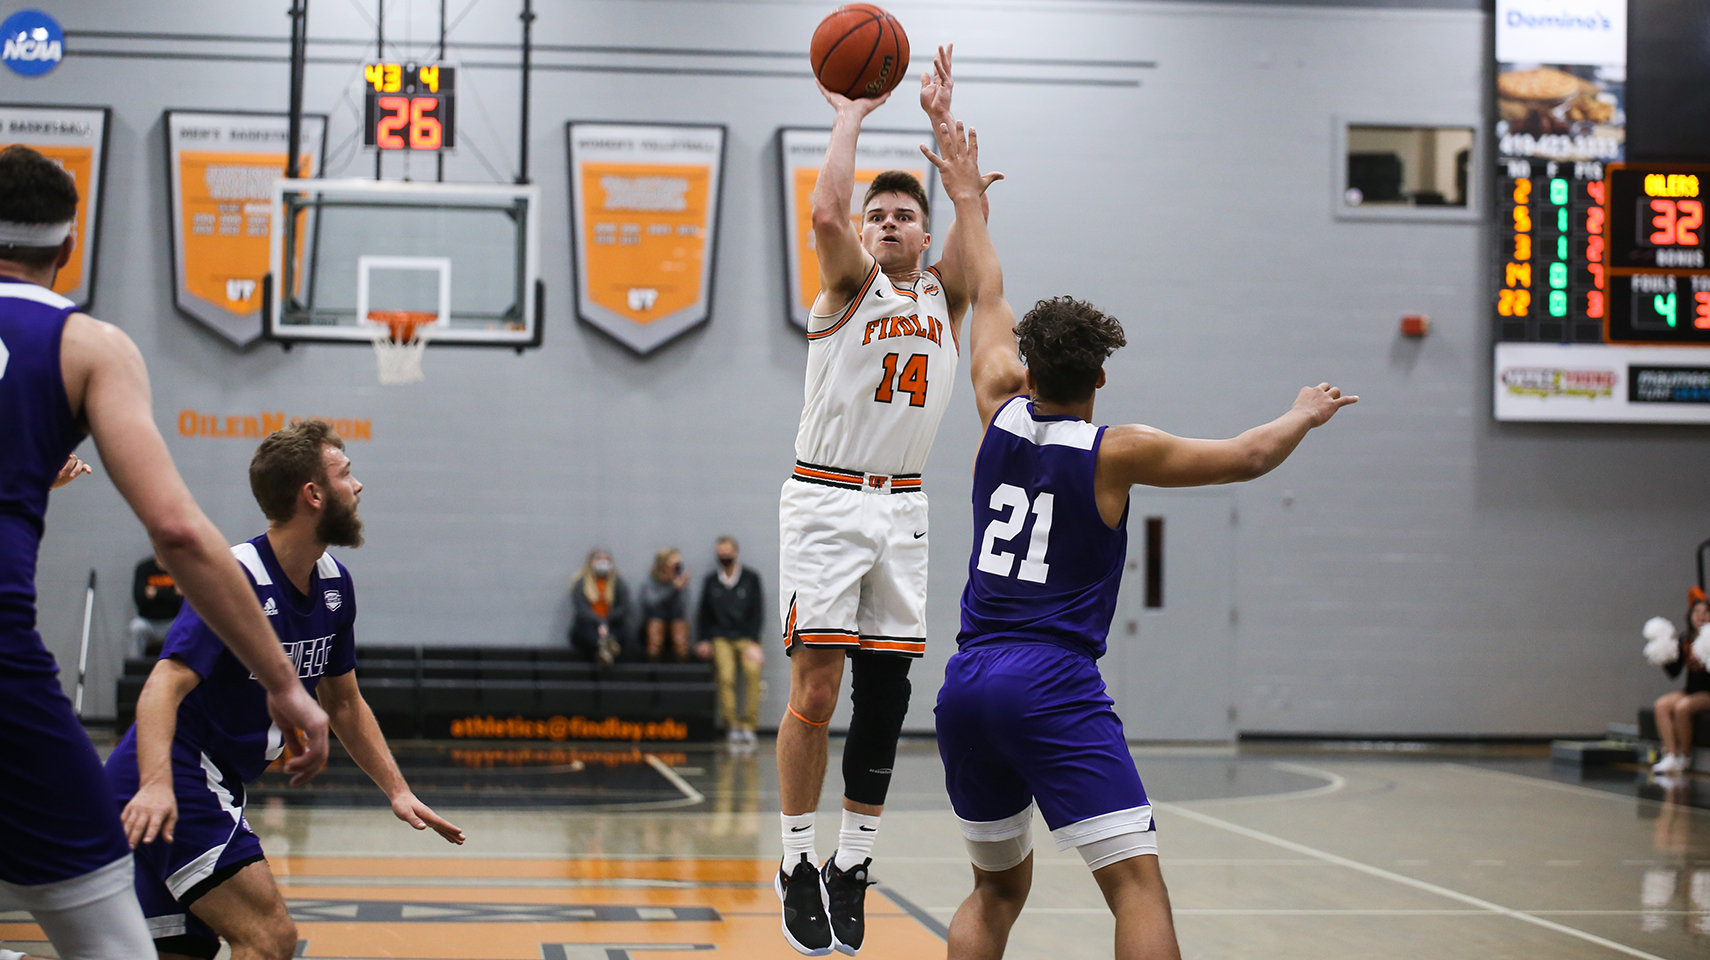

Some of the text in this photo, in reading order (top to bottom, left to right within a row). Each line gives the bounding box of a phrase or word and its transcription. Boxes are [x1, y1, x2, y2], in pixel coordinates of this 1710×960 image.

[1507, 11, 1611, 29] Domino's
[2, 39, 62, 62] NCAA
[364, 63, 439, 93] 43 4
[377, 96, 442, 149] 26
[1644, 174, 1700, 197] OILERS
[1650, 199, 1703, 245] 32
[1656, 249, 1704, 268] BONUS
[1631, 275, 1676, 294] FOULS
[1653, 292, 1677, 328] 4
[862, 314, 944, 349] FINDLAY
[874, 352, 929, 408] 14
[868, 475, 889, 491] UF
[976, 483, 1055, 584] 21
[450, 715, 688, 742] athletics@findlay.edu
